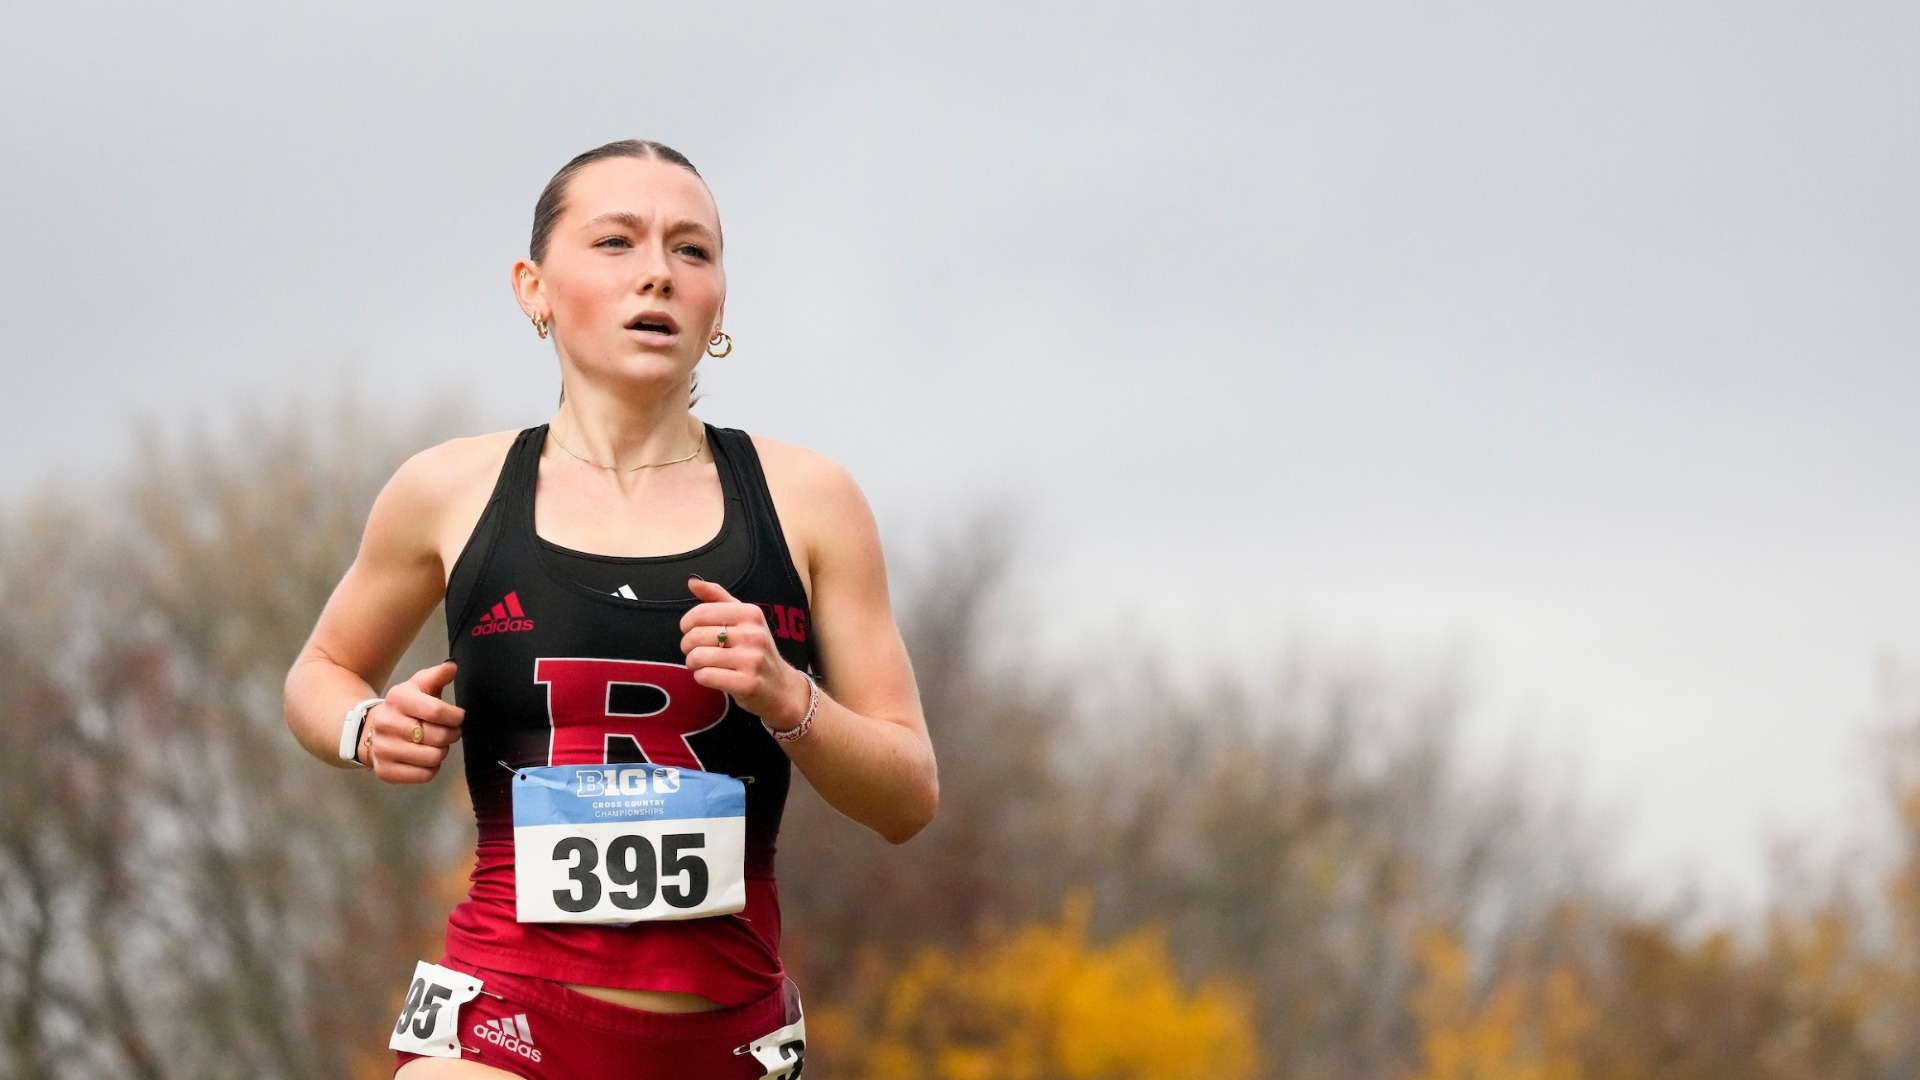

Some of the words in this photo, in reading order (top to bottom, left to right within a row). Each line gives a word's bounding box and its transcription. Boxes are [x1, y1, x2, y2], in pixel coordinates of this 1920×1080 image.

[471, 617, 534, 637] adidas
[534, 657, 729, 771] R
[592, 801, 621, 809] CROSS
[595, 808, 664, 818] CHAMPIONSHIPS
[552, 833, 709, 913] 395
[473, 1024, 542, 1063] adidas
